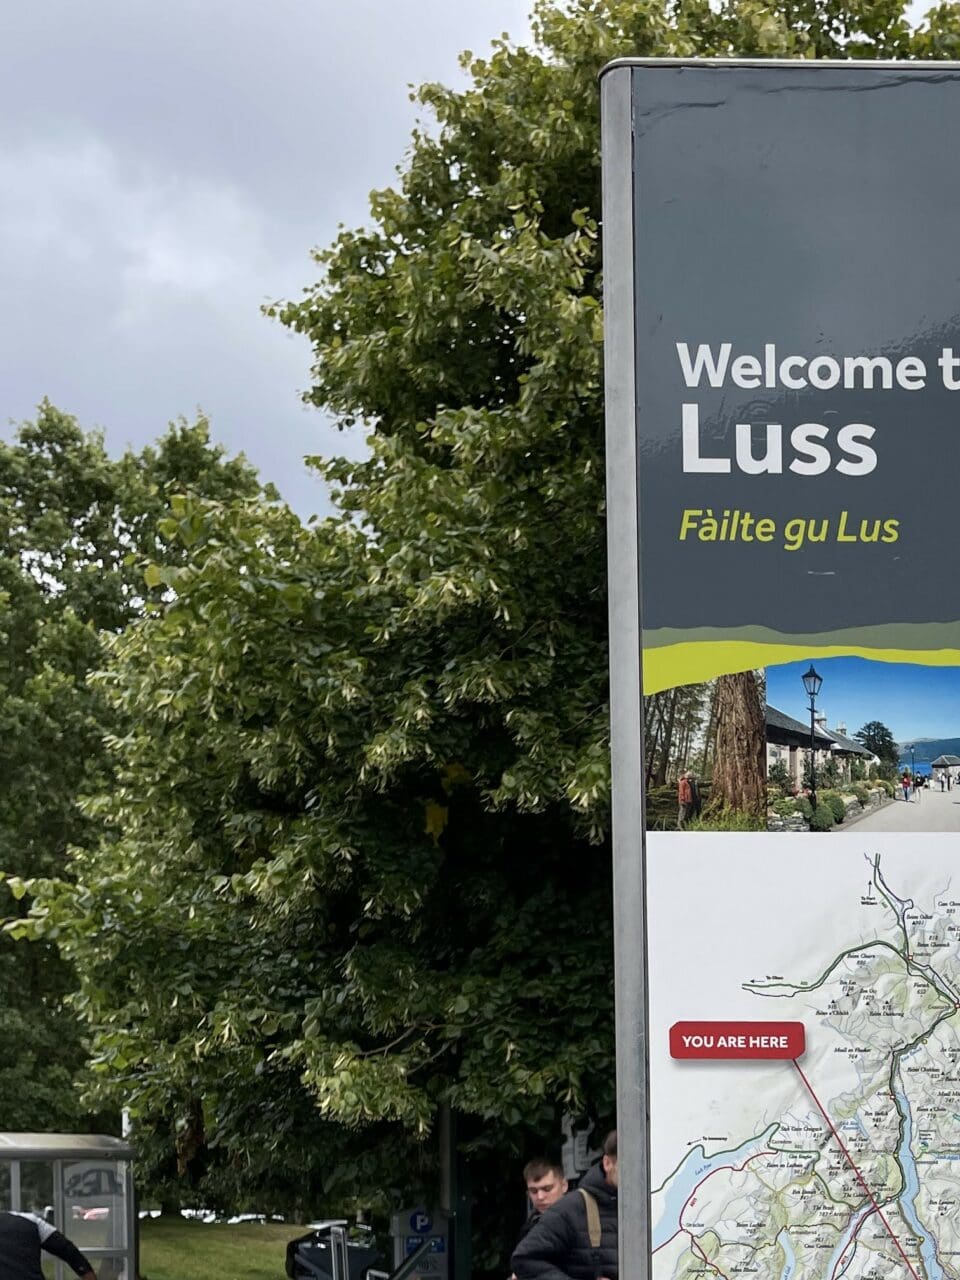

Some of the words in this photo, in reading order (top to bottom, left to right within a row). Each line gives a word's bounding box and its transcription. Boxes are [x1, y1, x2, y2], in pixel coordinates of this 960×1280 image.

[676, 343, 926, 389] Welcome
[682, 404, 877, 475] Luss
[680, 510, 775, 541] Fàilte
[784, 519, 828, 550] gu
[837, 511, 899, 542] Lus
[682, 1036, 714, 1047] YOU
[717, 1036, 746, 1048] ARE
[750, 1037, 788, 1048] HERE
